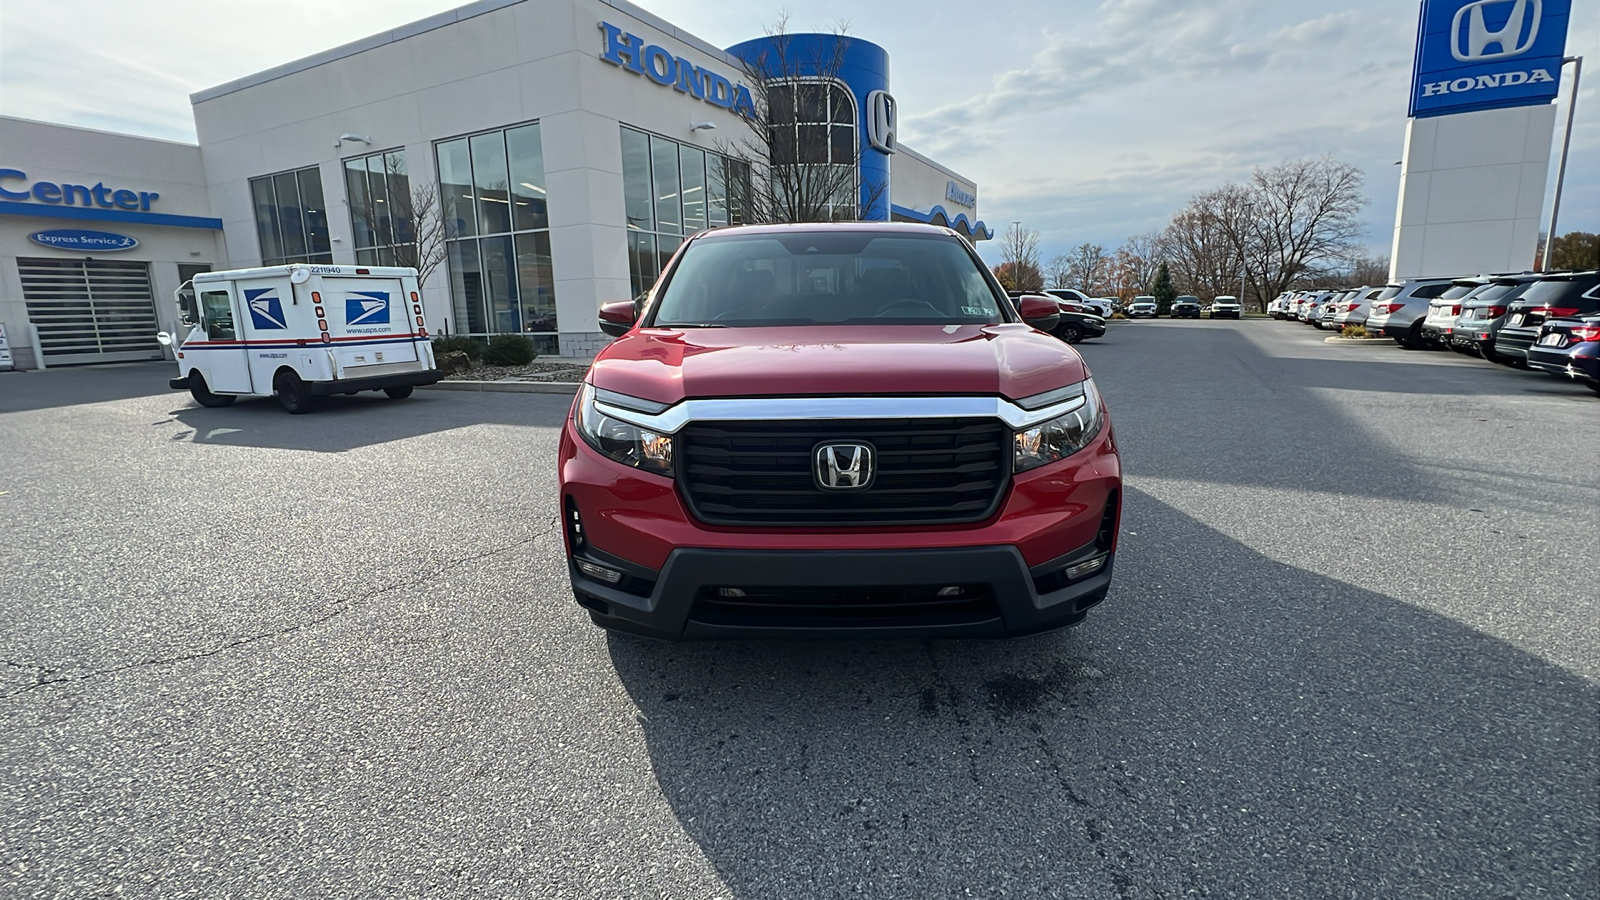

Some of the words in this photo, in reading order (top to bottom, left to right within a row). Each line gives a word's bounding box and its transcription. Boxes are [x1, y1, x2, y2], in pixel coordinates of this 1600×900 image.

[598, 20, 757, 120] HONDA
[1421, 68, 1554, 97] HONDA
[0, 168, 160, 211] Center
[37, 234, 79, 244] Express
[80, 236, 118, 245] Service
[310, 266, 341, 274] 2211940
